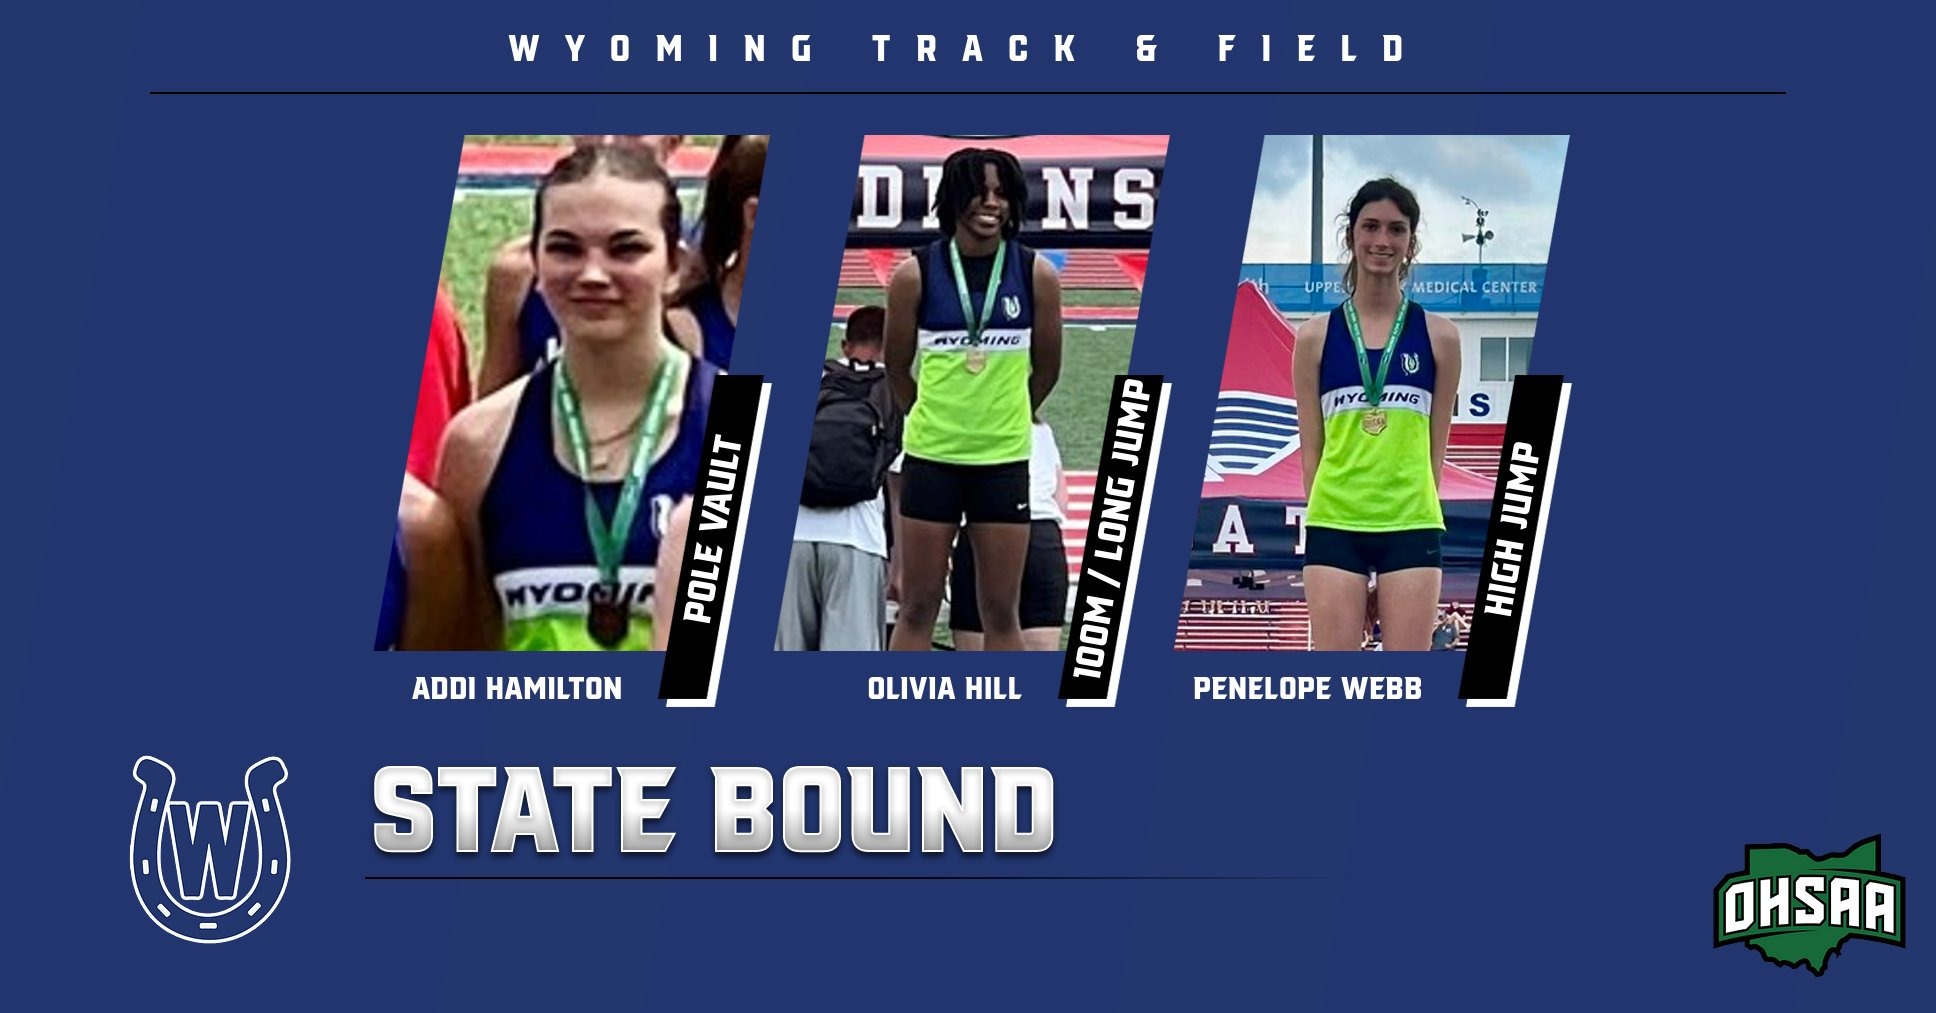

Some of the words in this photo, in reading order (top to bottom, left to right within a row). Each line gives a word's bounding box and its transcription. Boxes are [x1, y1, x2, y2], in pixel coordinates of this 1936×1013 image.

[856, 165, 1156, 231] DINS
[1305, 281, 1346, 293] UPPE
[1413, 281, 1477, 293] MEDICAL
[1481, 281, 1537, 293] CENTER
